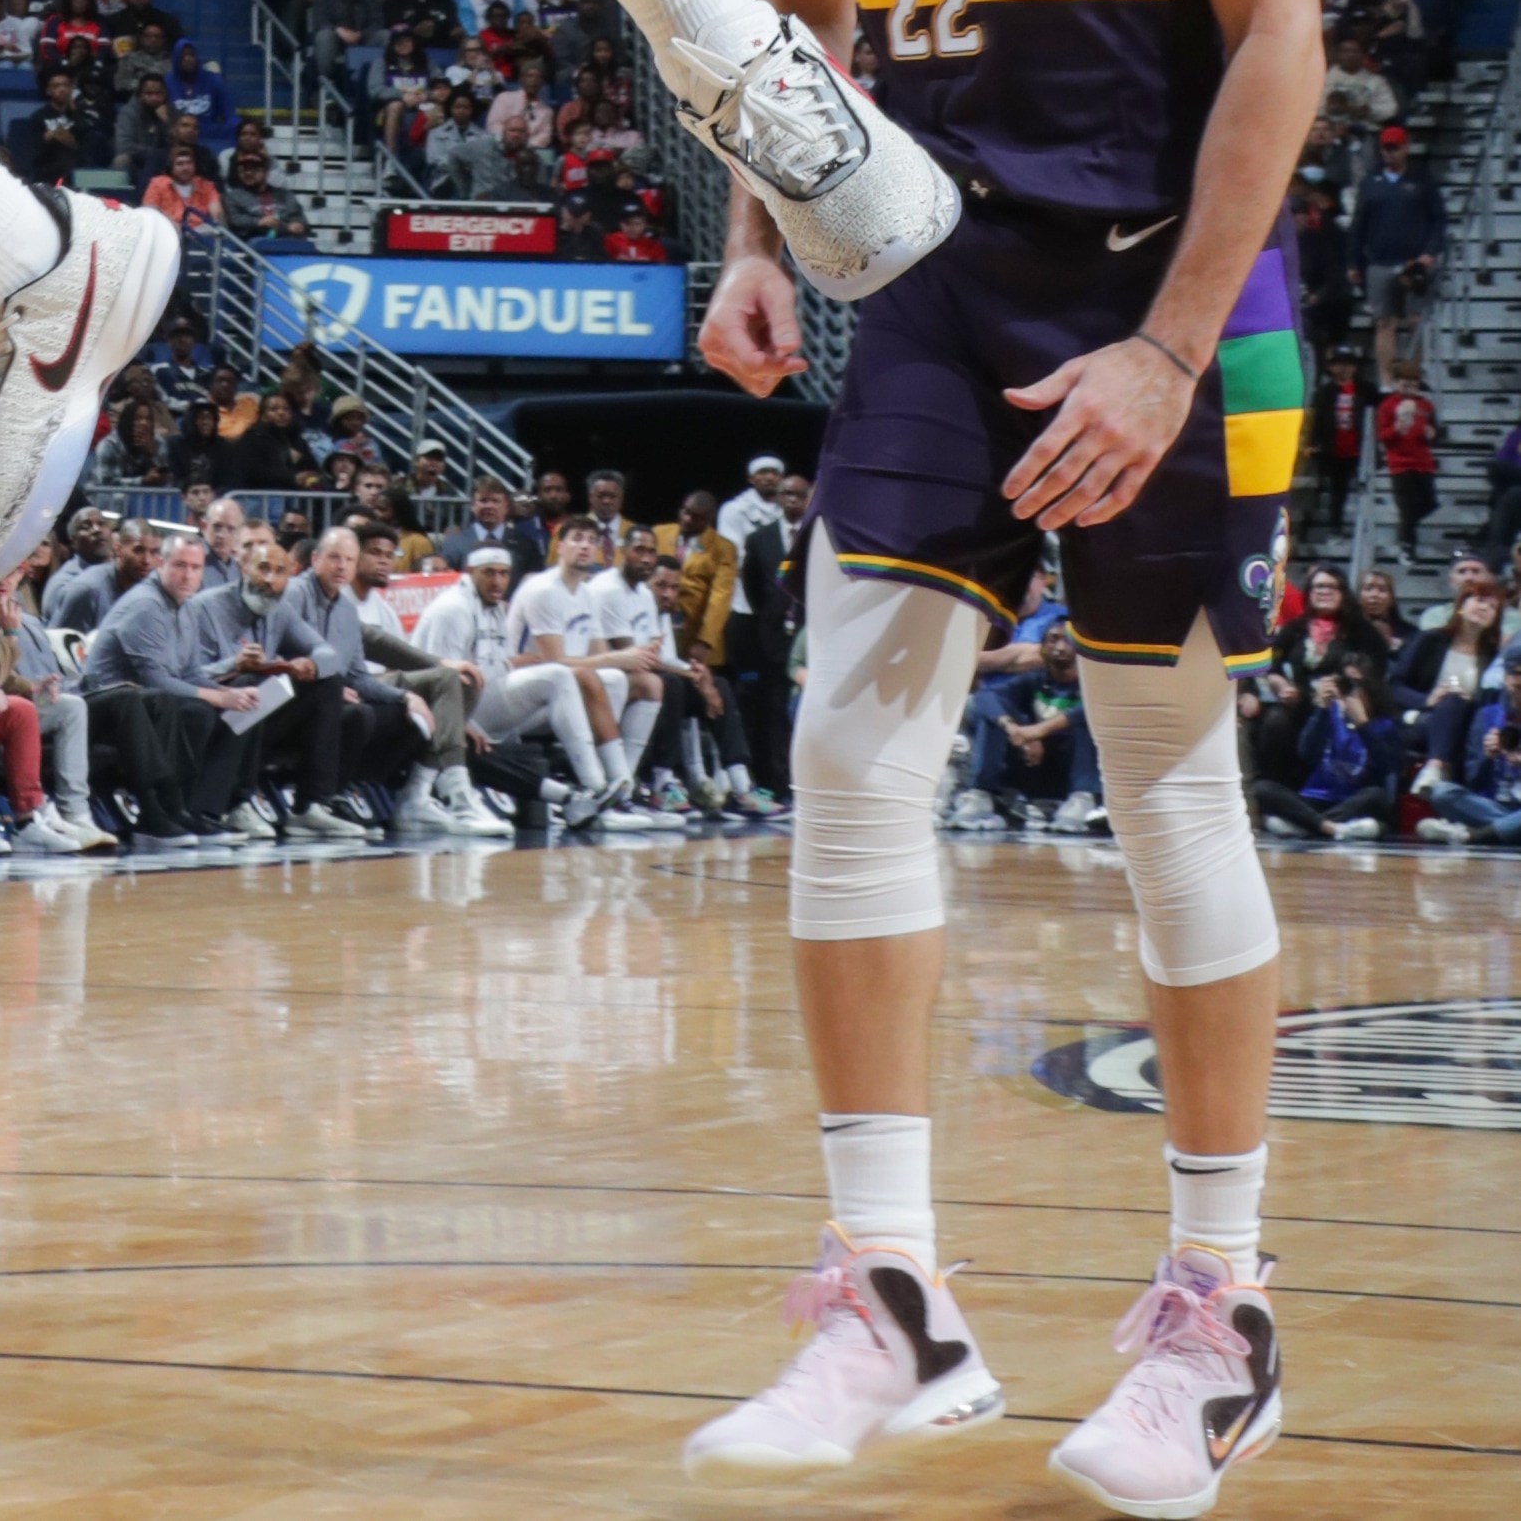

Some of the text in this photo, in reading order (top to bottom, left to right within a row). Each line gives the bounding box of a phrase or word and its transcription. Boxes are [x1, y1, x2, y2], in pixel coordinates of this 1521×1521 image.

[409, 214, 537, 235] EMERGENCY
[448, 234, 497, 252] EXIT
[383, 283, 654, 337] FANDUEL
